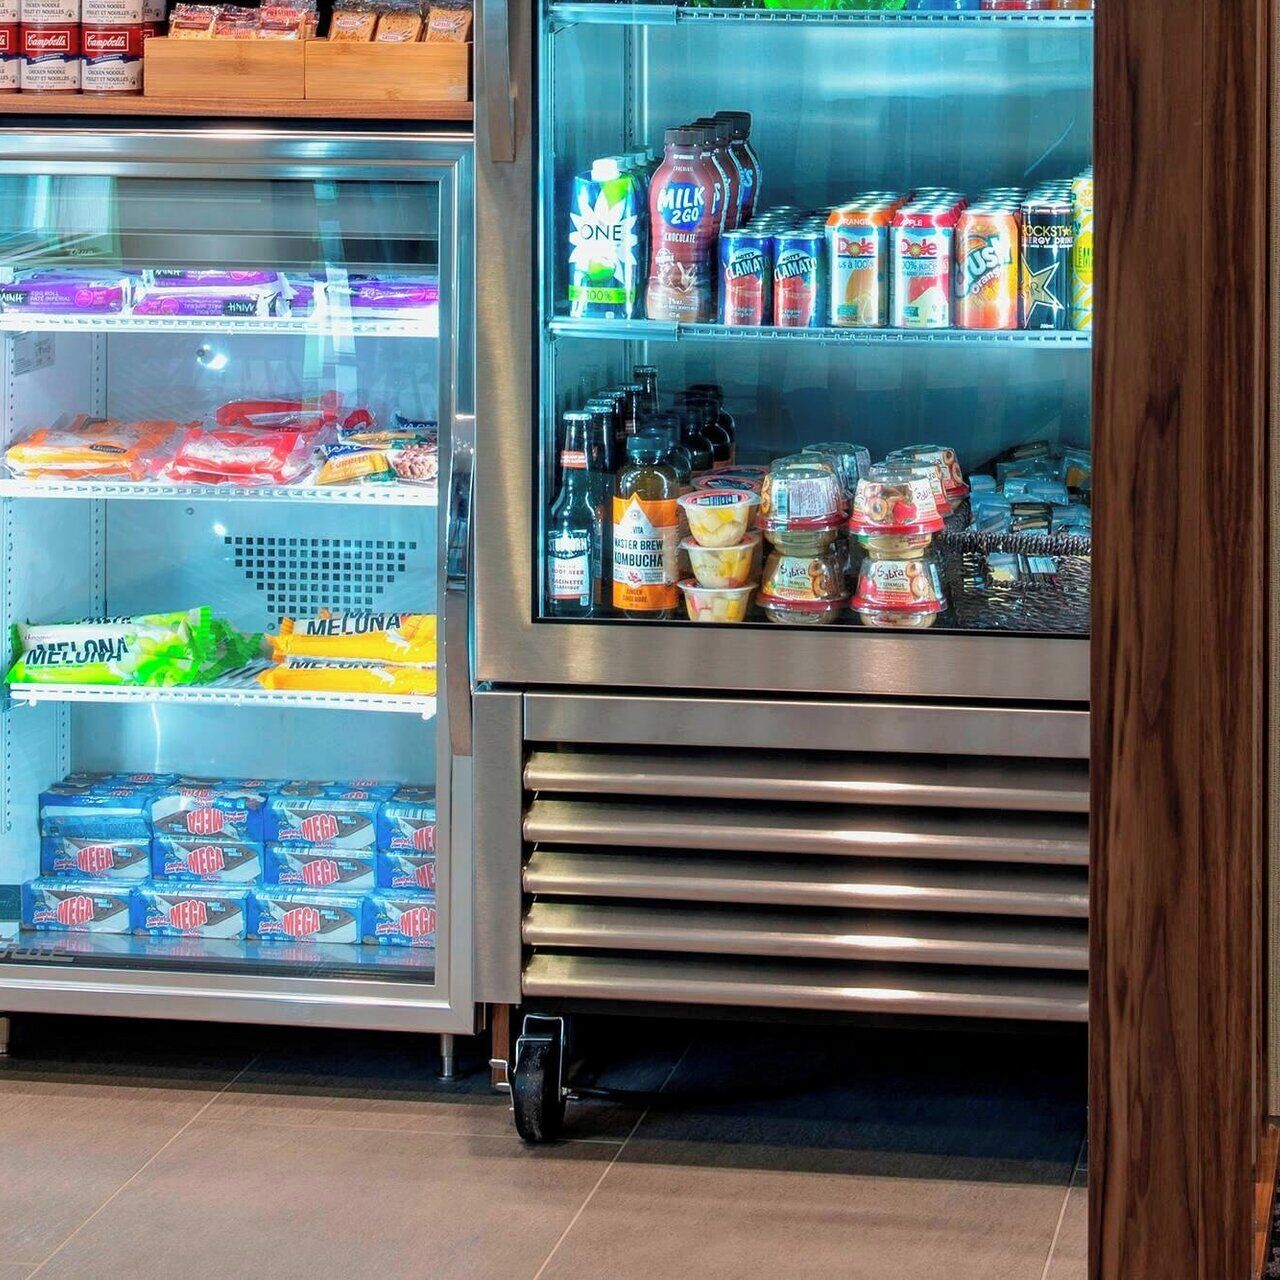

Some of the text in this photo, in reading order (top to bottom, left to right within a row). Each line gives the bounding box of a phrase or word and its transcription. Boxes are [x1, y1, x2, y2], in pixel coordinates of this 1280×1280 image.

[27, 34, 66, 47] Campbell's
[87, 35, 125, 48] Campbell's
[657, 186, 705, 213] MILK
[671, 207, 699, 225] 2GO
[581, 224, 621, 242] ONE
[665, 233, 696, 243] CHOCOLATE
[837, 237, 874, 257] Dole
[900, 237, 937, 258] Dole
[774, 257, 817, 281] CLAMATO
[972, 265, 1002, 294] orang
[633, 526, 644, 535] VITA
[640, 539, 664, 550] BREW
[615, 552, 664, 568] KOMBUCHA
[780, 564, 807, 578] Sabra
[877, 565, 905, 580] Sabra
[307, 614, 401, 636] MELONA
[301, 814, 339, 842] MEGA
[77, 845, 114, 873] MEGA
[187, 845, 224, 875] MEGA
[302, 859, 339, 887] MEGA
[57, 895, 94, 925] MEGA
[170, 899, 207, 929] MEGA
[283, 906, 320, 936] MEGA
